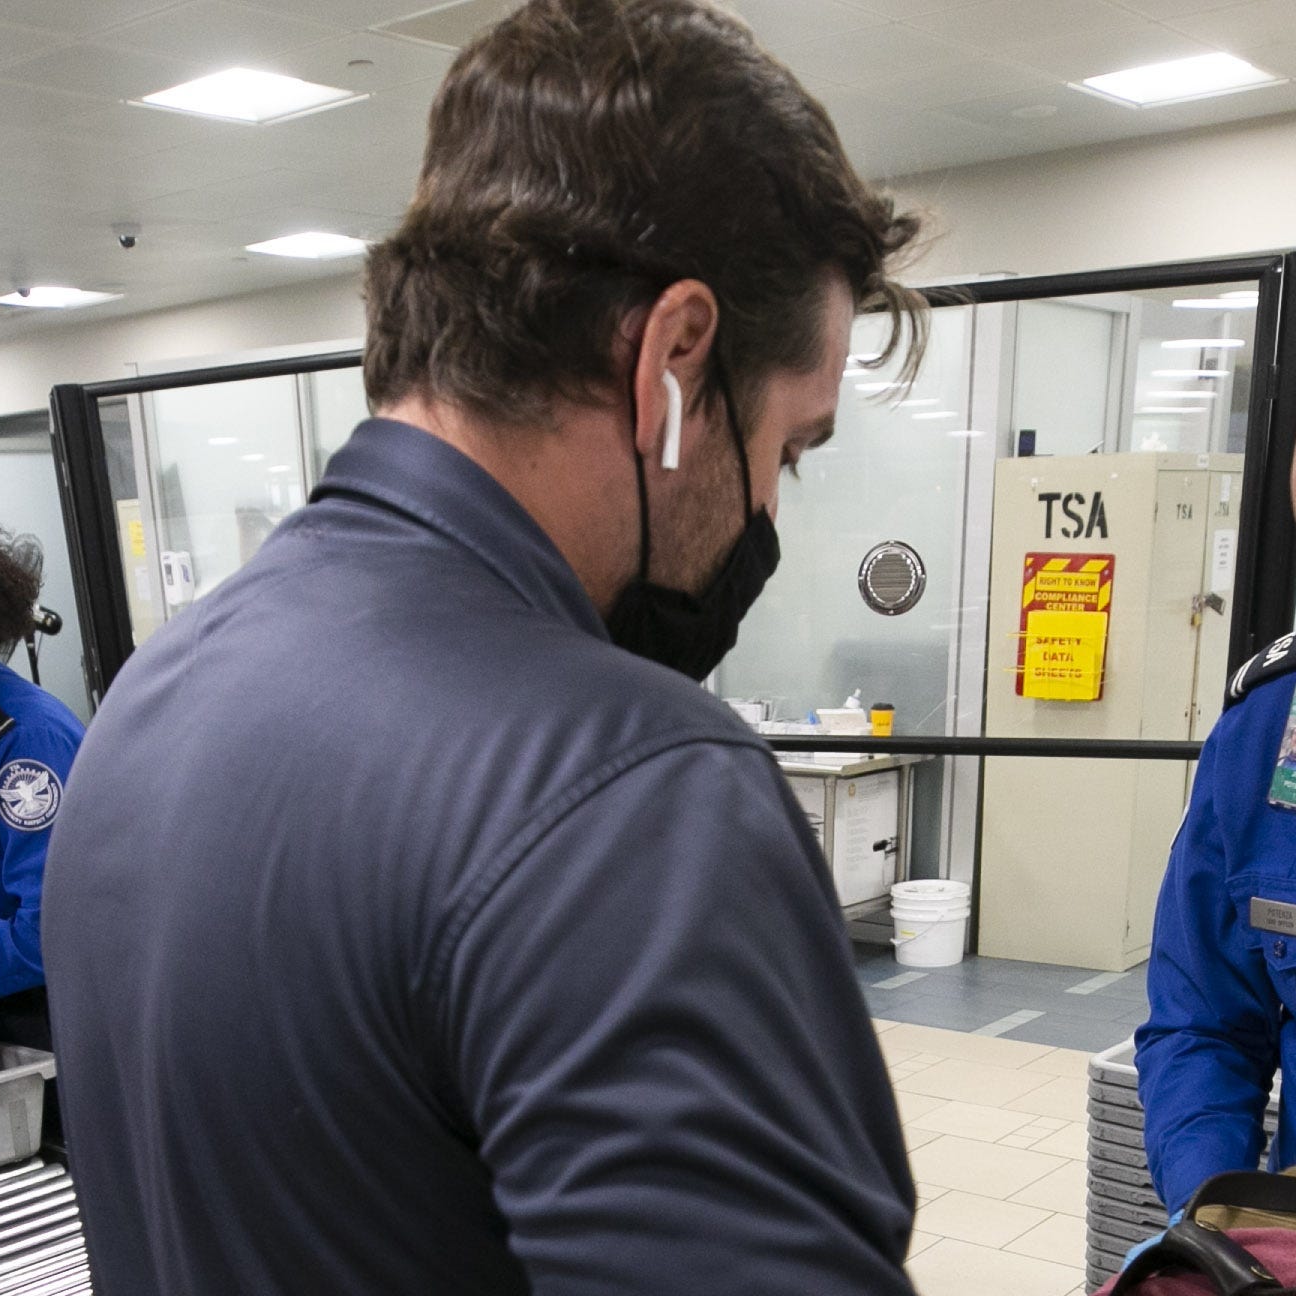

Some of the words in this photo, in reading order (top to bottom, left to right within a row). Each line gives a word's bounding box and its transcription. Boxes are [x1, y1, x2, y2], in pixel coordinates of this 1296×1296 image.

[1037, 491, 1109, 539] TSA
[1176, 503, 1193, 520] TSA
[1039, 576, 1061, 586] RIGHT
[1062, 577, 1073, 587] TO
[1074, 577, 1097, 588] KNOW
[1035, 592, 1098, 603] COMPLIANCE
[1046, 602, 1086, 612] CENTER
[1035, 636, 1082, 646] SAFETY
[1042, 651, 1075, 662] DATA
[1034, 667, 1083, 679] SHEETS
